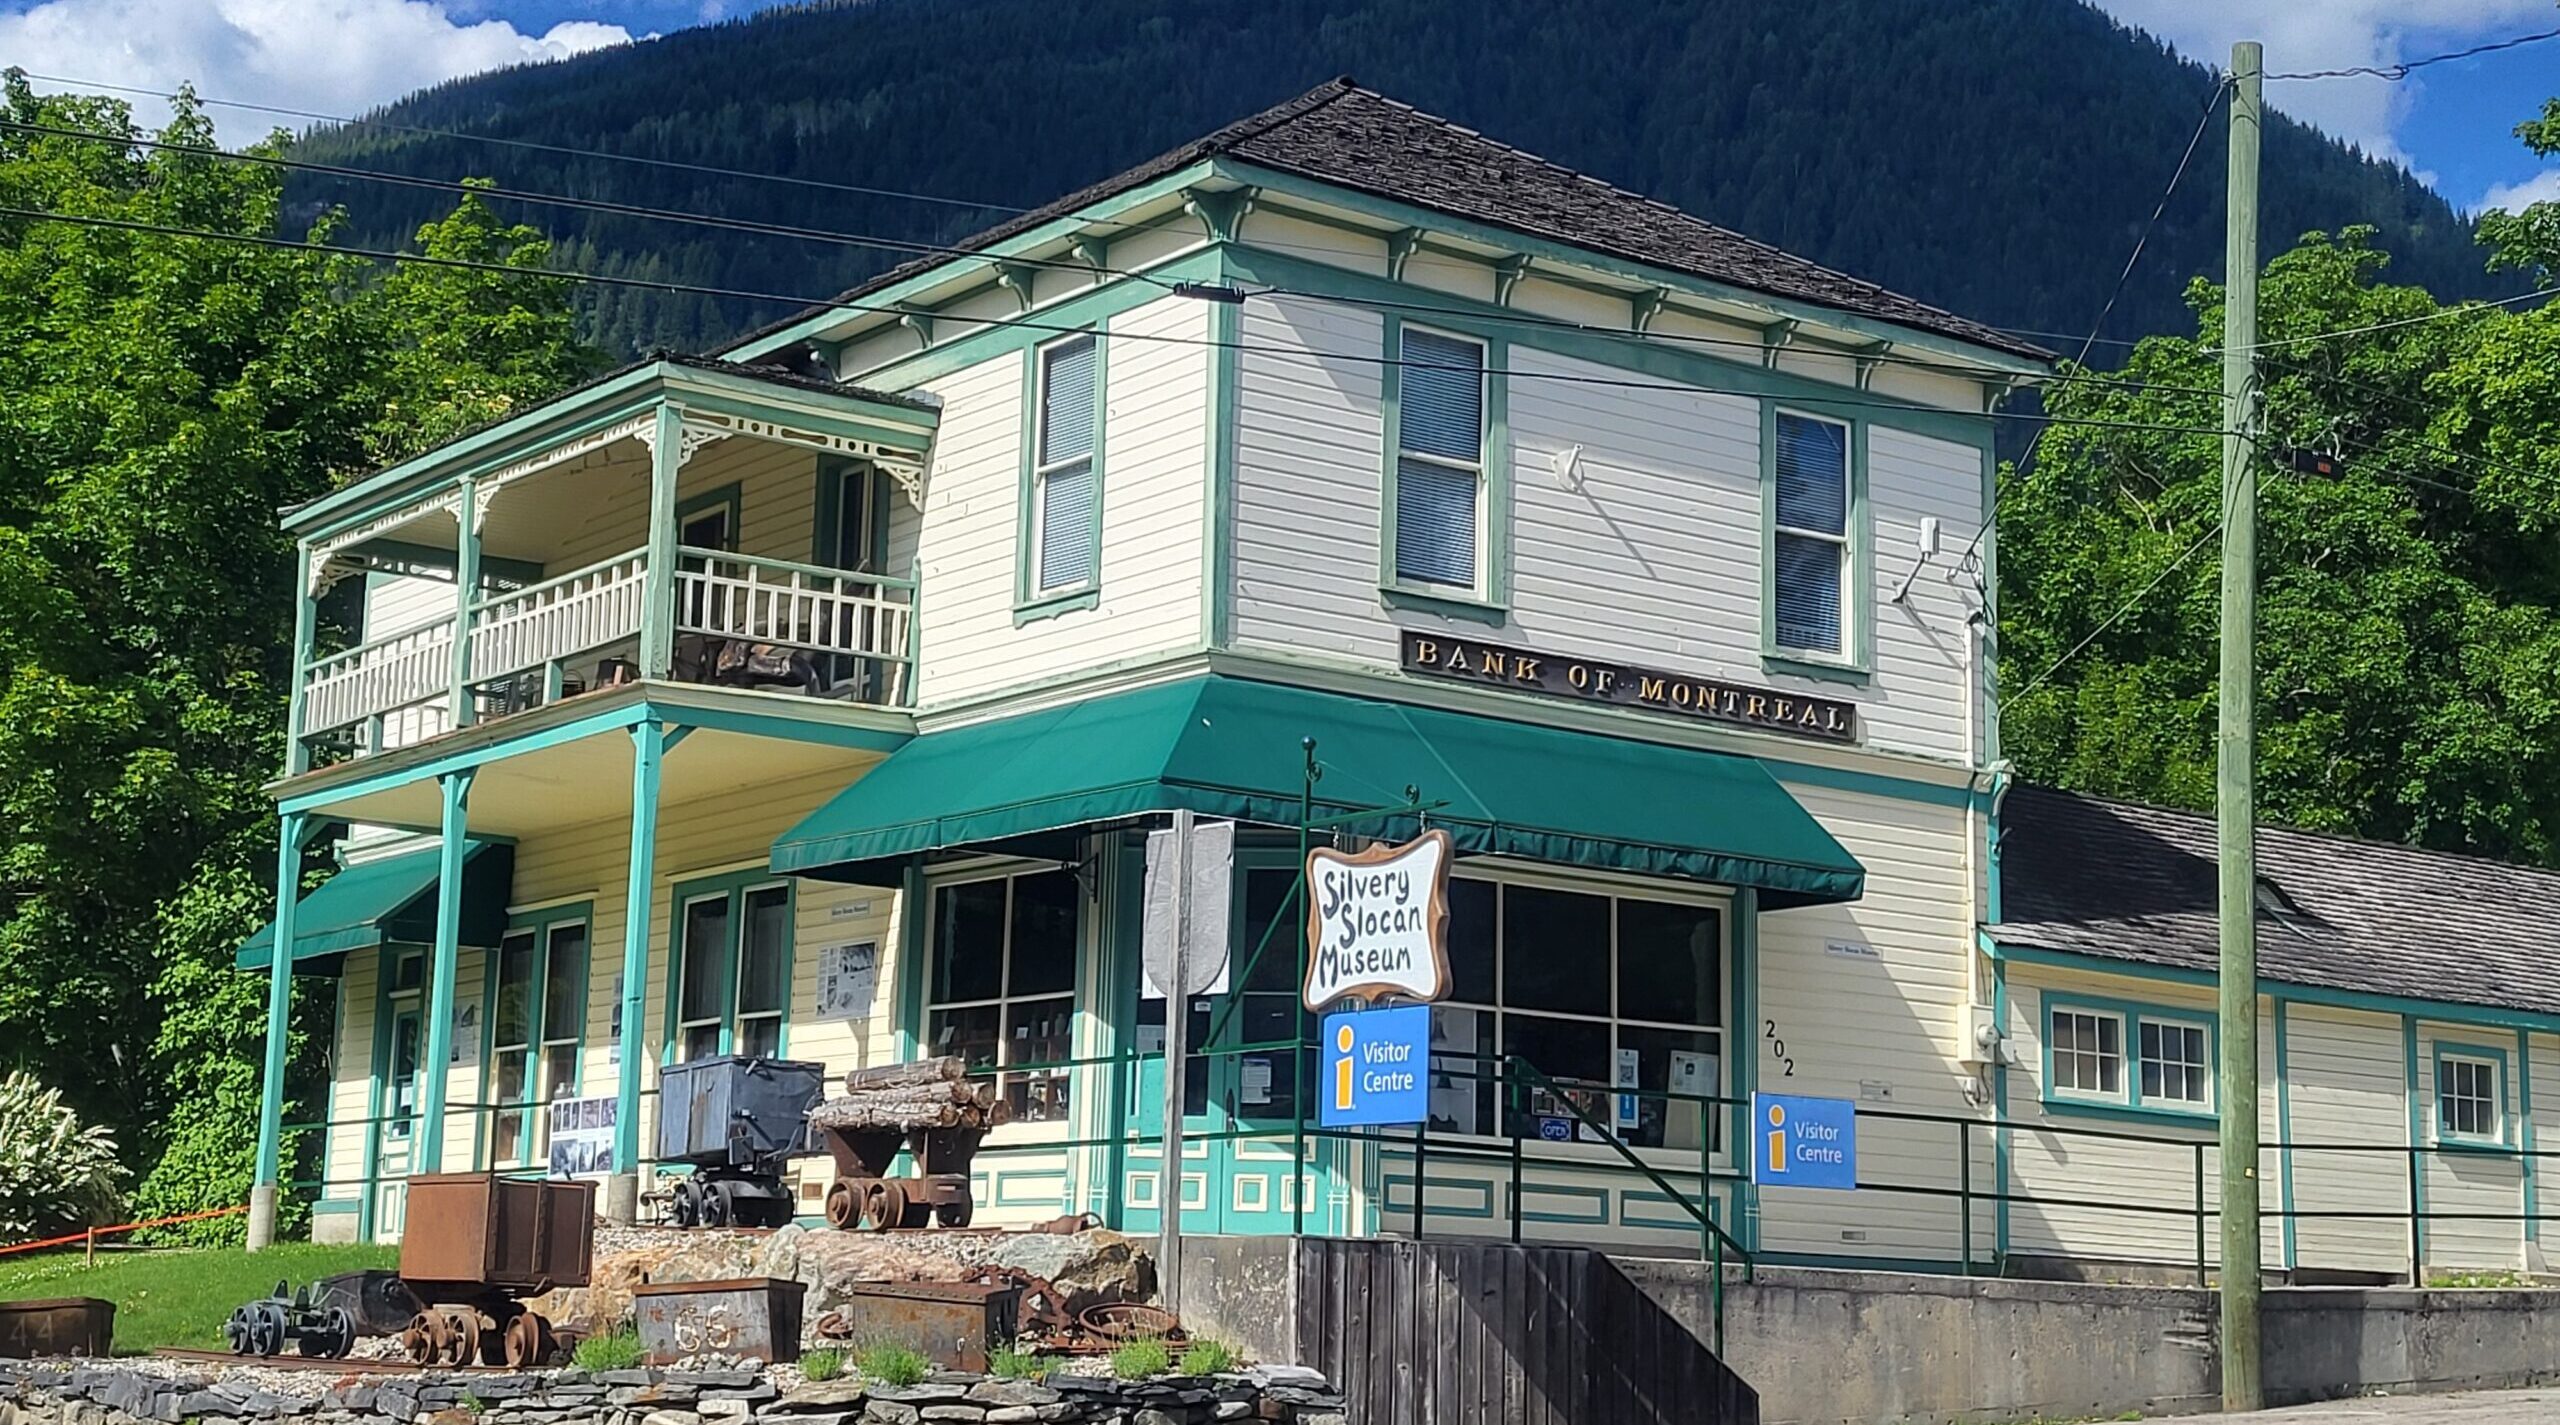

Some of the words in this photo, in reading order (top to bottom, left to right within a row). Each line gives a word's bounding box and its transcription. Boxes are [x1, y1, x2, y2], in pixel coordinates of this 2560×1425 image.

[1415, 639, 1542, 681] BANK
[1567, 664, 1616, 693] OF
[1638, 675, 1846, 731] MONTREAL
[1322, 869, 1411, 920] Silvery
[1339, 902, 1423, 950] Slocan
[1318, 944, 1412, 989] Museum
[1362, 1040, 1412, 1064] Visitor
[1765, 1019, 1794, 1077] 202
[1362, 1070, 1414, 1093] Centre
[1794, 1121, 1840, 1141] Visitor
[1795, 1143, 1843, 1164] Centre
[9, 1312, 54, 1348] 44
